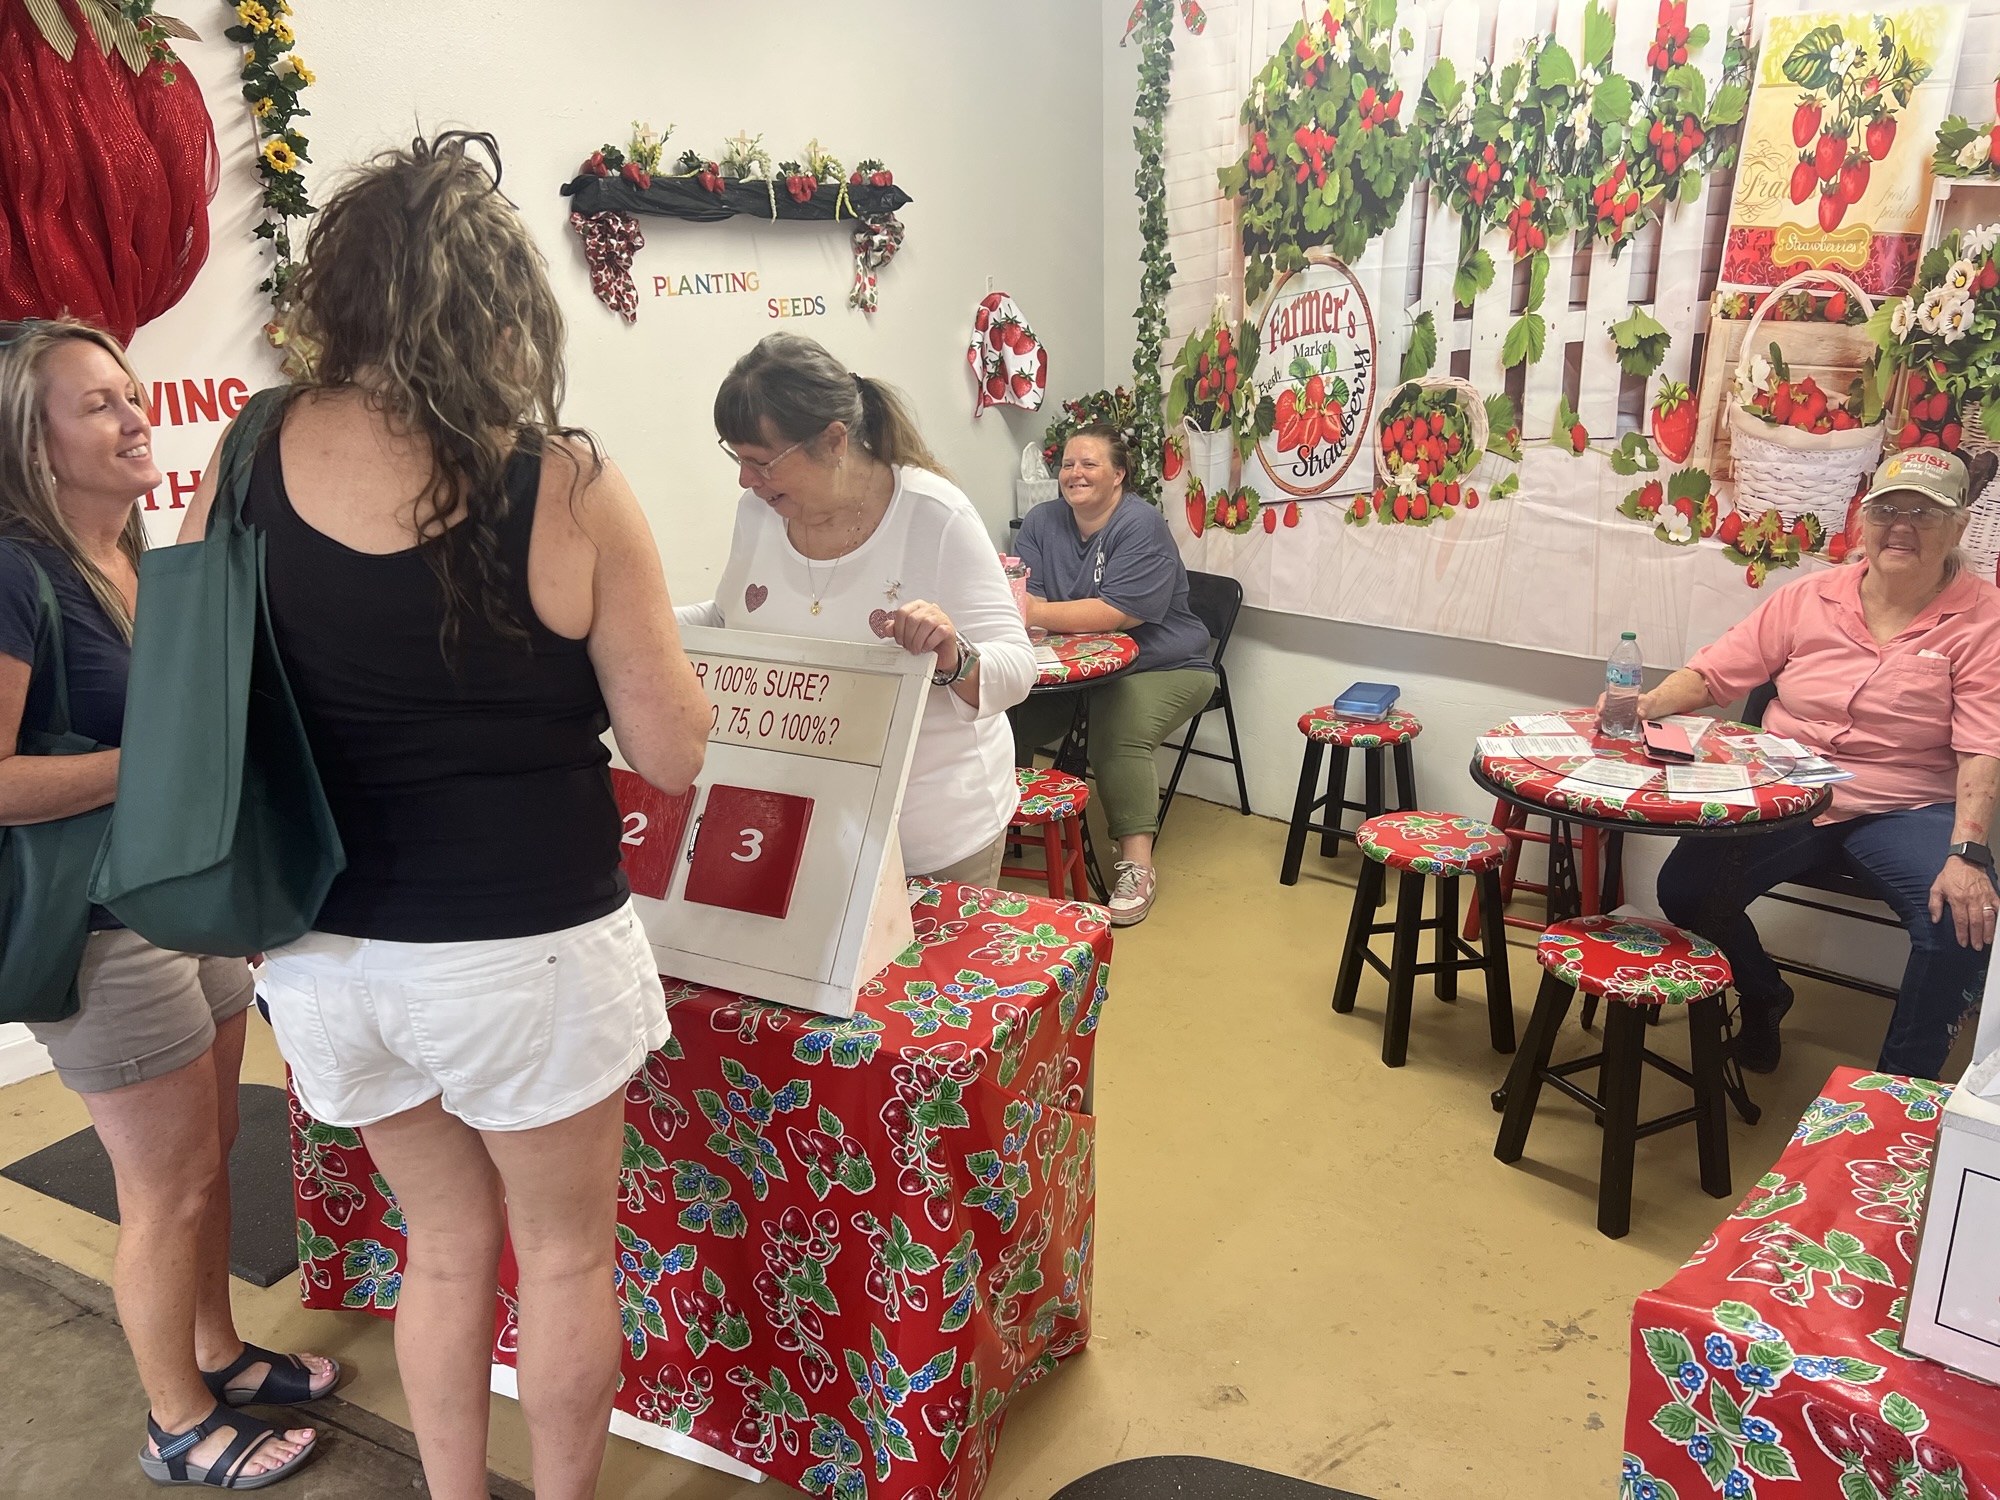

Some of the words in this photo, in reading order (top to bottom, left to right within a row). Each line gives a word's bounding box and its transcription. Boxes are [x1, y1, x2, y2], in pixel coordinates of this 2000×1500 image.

[1785, 232, 1857, 253] Strawberries
[652, 271, 760, 297] PLANTING
[767, 295, 826, 319] SEEDS
[1269, 288, 1356, 355] Farmer's
[1292, 339, 1333, 359] Market
[1292, 343, 1371, 478] Strawberry
[1903, 453, 1951, 471] PUSH
[714, 665, 758, 696] 100%
[763, 669, 830, 702] SURE?
[727, 706, 751, 740] 75,
[781, 712, 840, 745] 100%?
[621, 811, 648, 846] 2
[730, 828, 764, 862] 3
